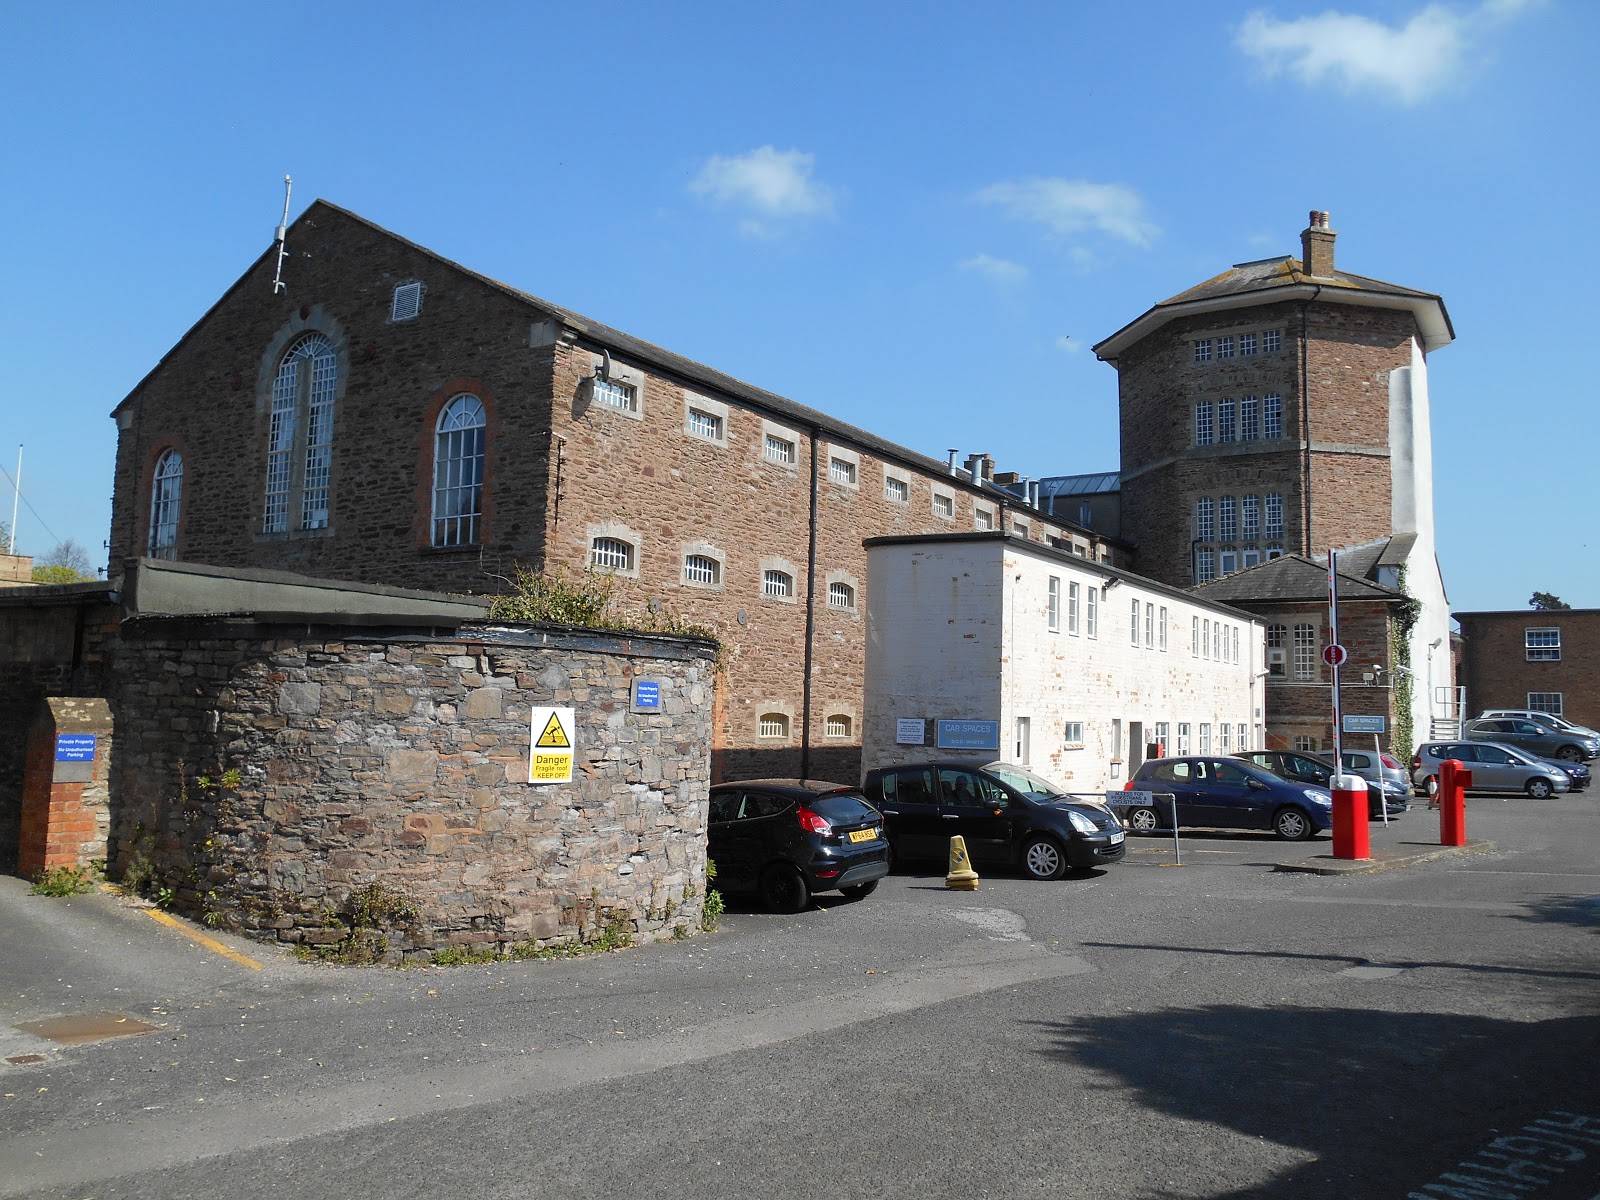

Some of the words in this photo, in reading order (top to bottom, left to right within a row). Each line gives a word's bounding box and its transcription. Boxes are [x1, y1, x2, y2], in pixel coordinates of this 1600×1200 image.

[945, 724, 960, 732] CAR
[962, 725, 991, 733] SPACES
[536, 755, 568, 766] Danger
